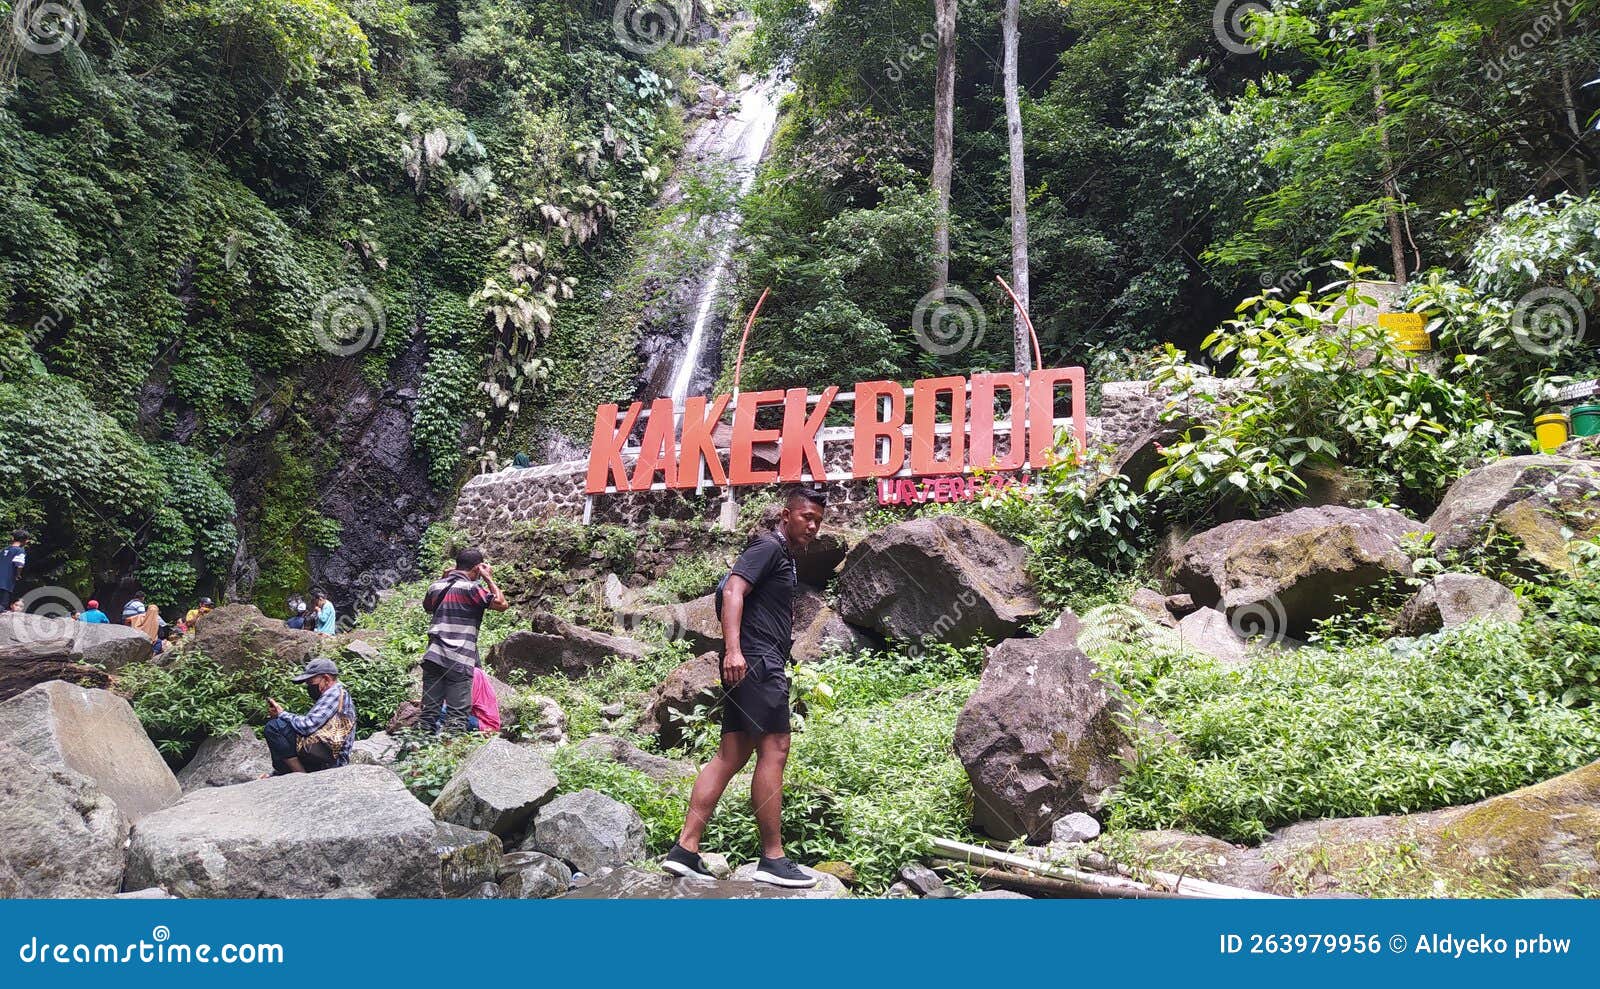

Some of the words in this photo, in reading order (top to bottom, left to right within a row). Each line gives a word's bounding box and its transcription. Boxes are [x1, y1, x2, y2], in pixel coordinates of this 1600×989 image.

[586, 385, 839, 495] KAKEK
[852, 366, 1087, 479] BODO
[877, 473, 1033, 506] WATERFA
